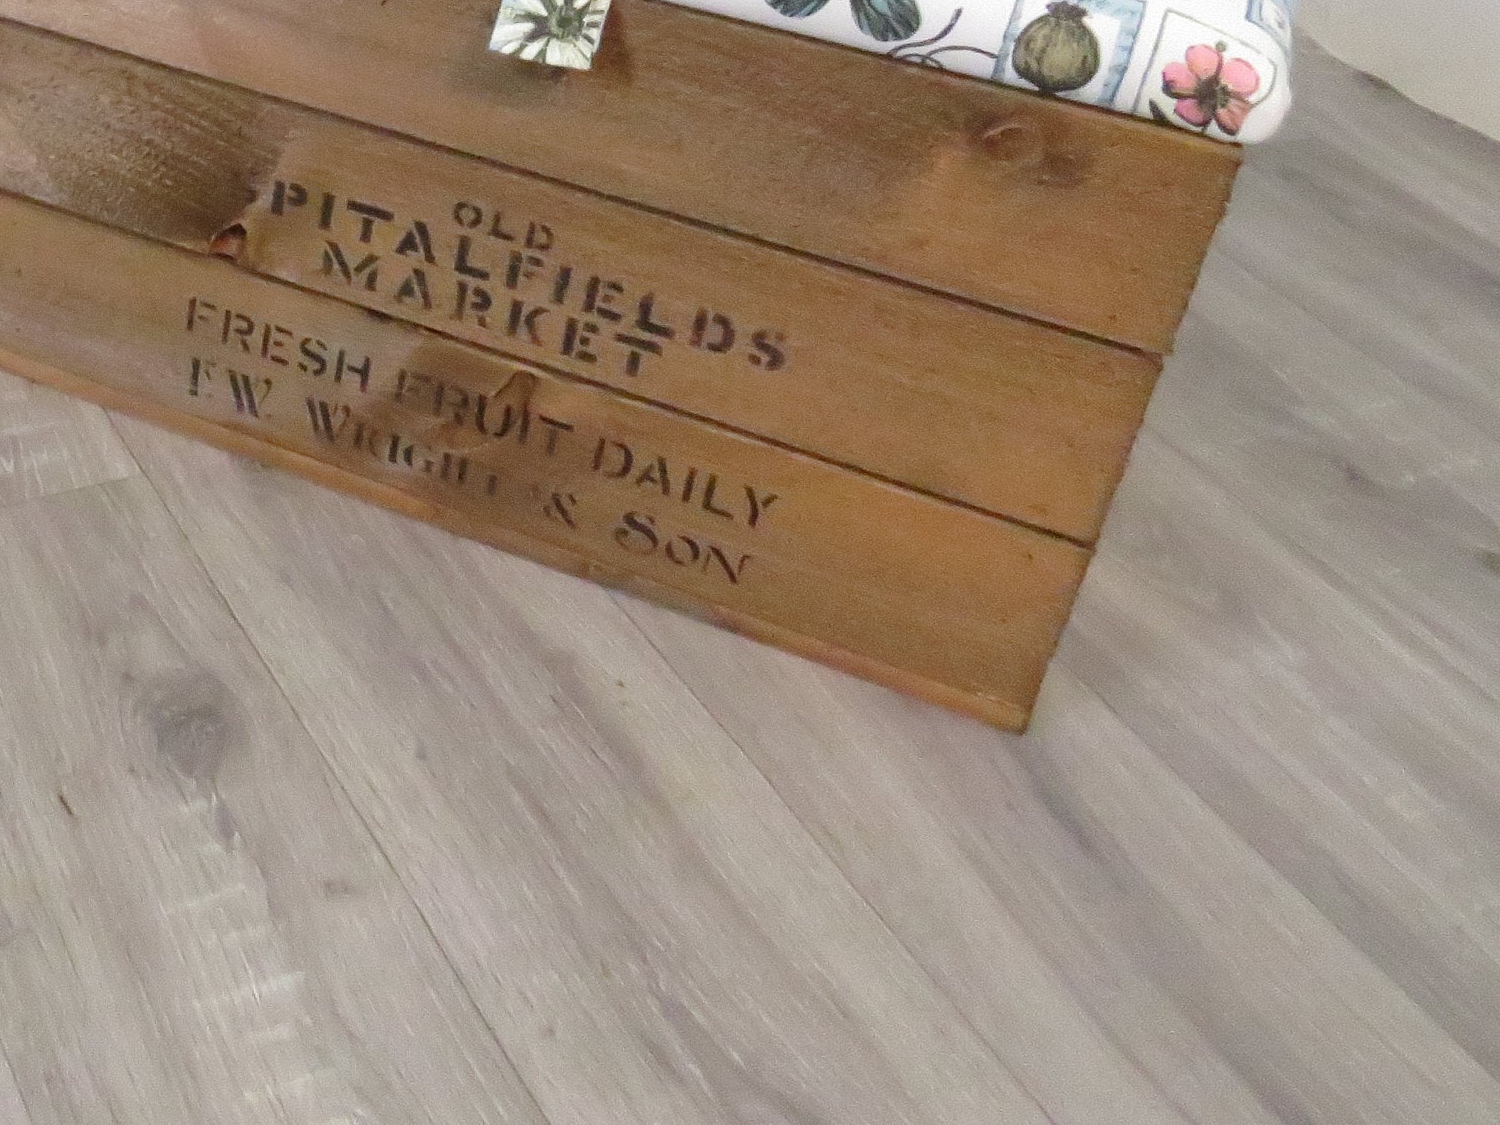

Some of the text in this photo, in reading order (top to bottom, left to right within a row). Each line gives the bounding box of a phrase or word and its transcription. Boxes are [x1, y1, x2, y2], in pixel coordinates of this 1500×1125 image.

[244, 179, 790, 373] PITALFIELDS
[453, 200, 555, 251] OLD
[320, 240, 662, 377] MARKET
[187, 296, 779, 528] FRESH FRUIT DAILY
